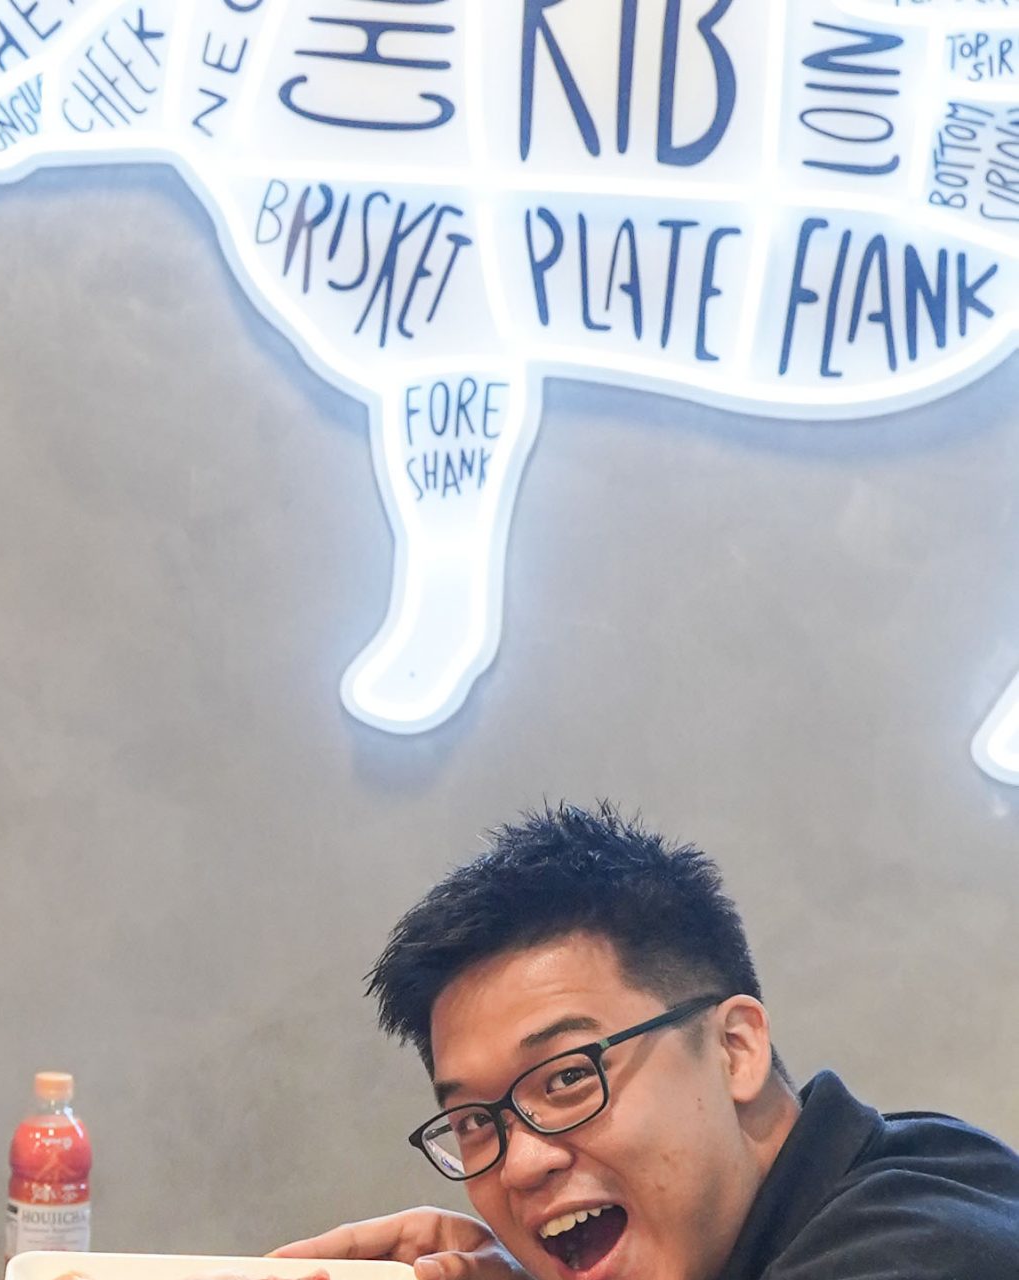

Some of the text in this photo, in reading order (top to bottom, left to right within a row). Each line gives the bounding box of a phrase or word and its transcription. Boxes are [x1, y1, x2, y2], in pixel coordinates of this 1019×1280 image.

[61, 8, 165, 133] CHEEK
[278, 0, 456, 131] CH
[519, 0, 737, 167] RIB
[798, 20, 905, 176] LOIN
[944, 32, 990, 71] TOP
[929, 101, 995, 209] BOTTOM
[255, 178, 473, 348] BRISKET
[525, 206, 742, 362] PLATE
[778, 217, 999, 378] FLANK
[405, 376, 511, 446] FORE
